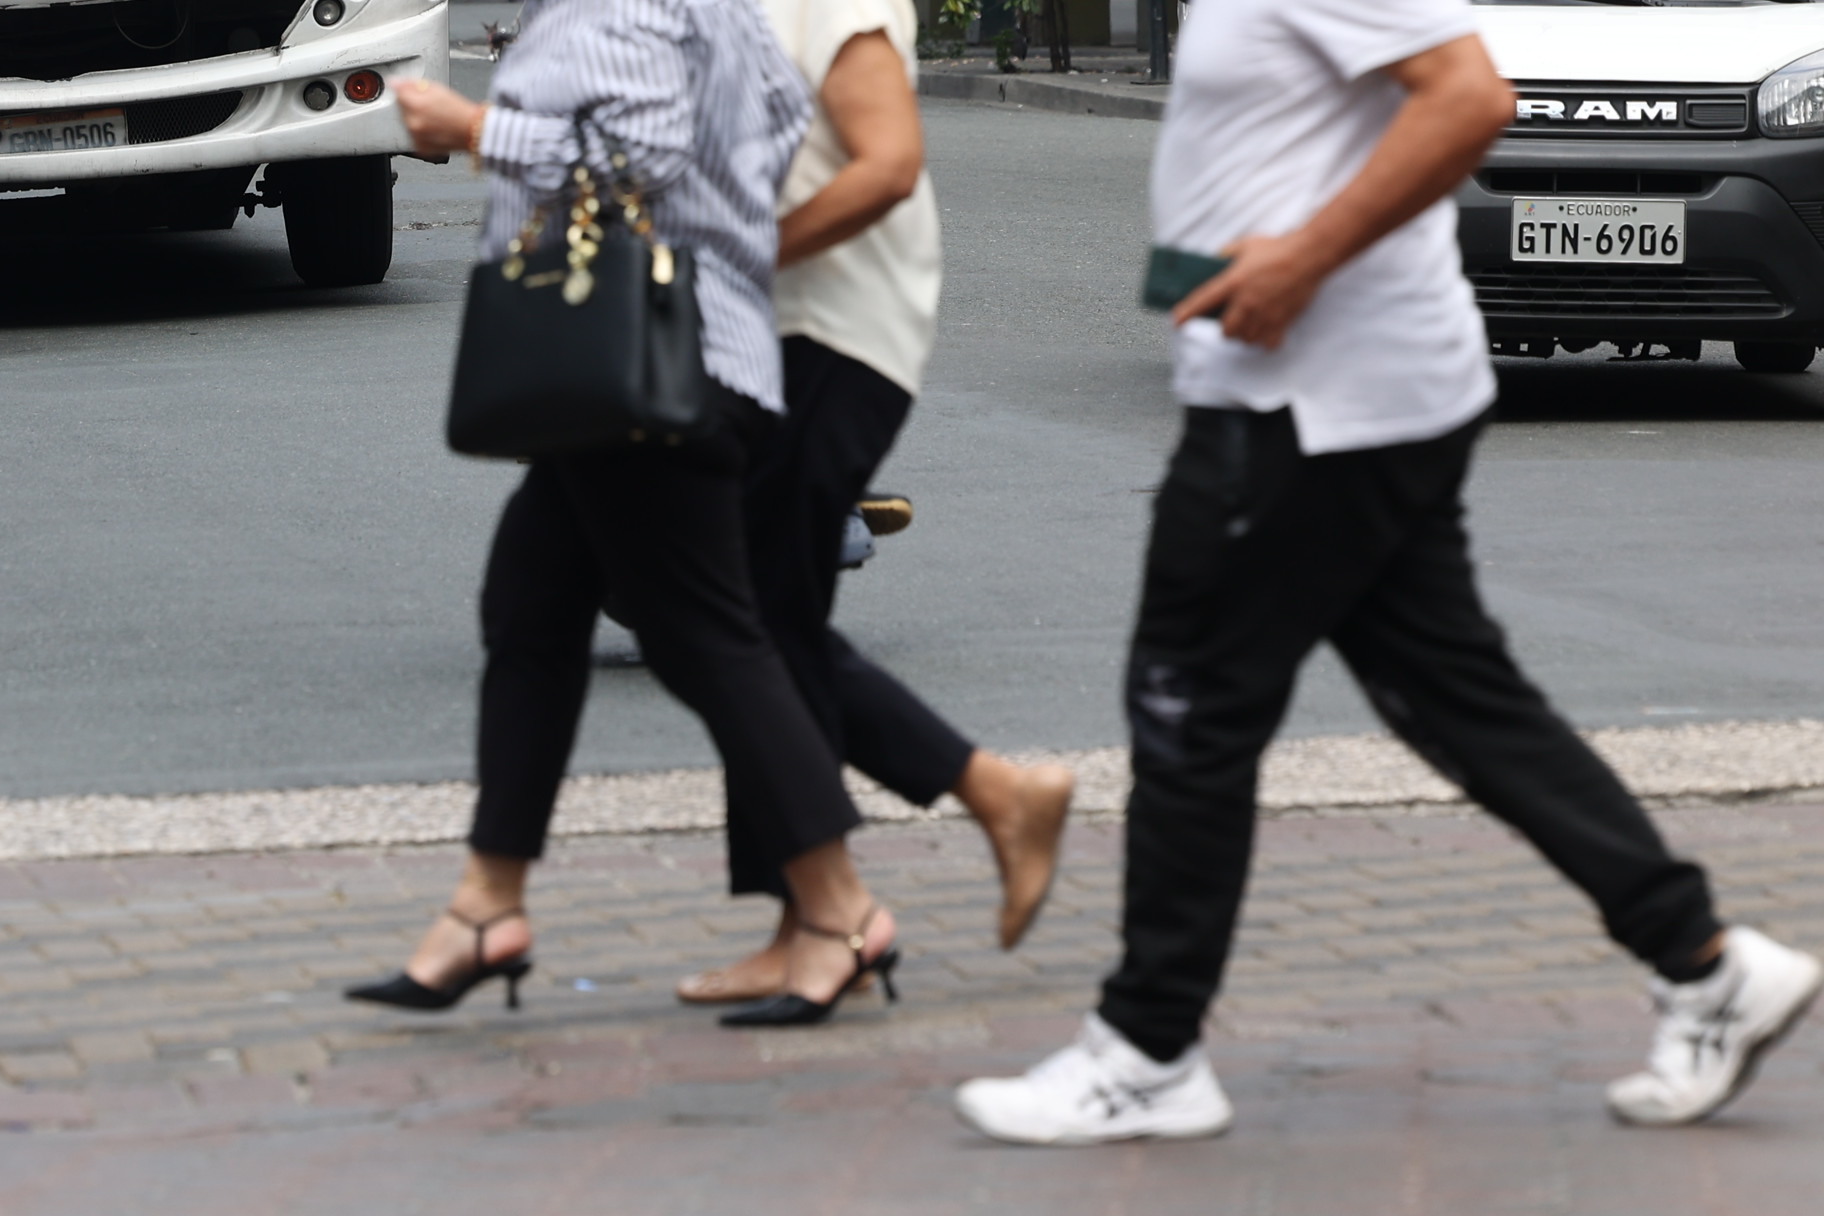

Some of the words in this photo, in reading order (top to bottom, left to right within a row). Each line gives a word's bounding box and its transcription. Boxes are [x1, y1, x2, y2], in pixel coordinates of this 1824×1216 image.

[1516, 100, 1678, 120] RAM
[1566, 204, 1631, 216] ECUADOR
[1518, 222, 1678, 256] GTN-6906
